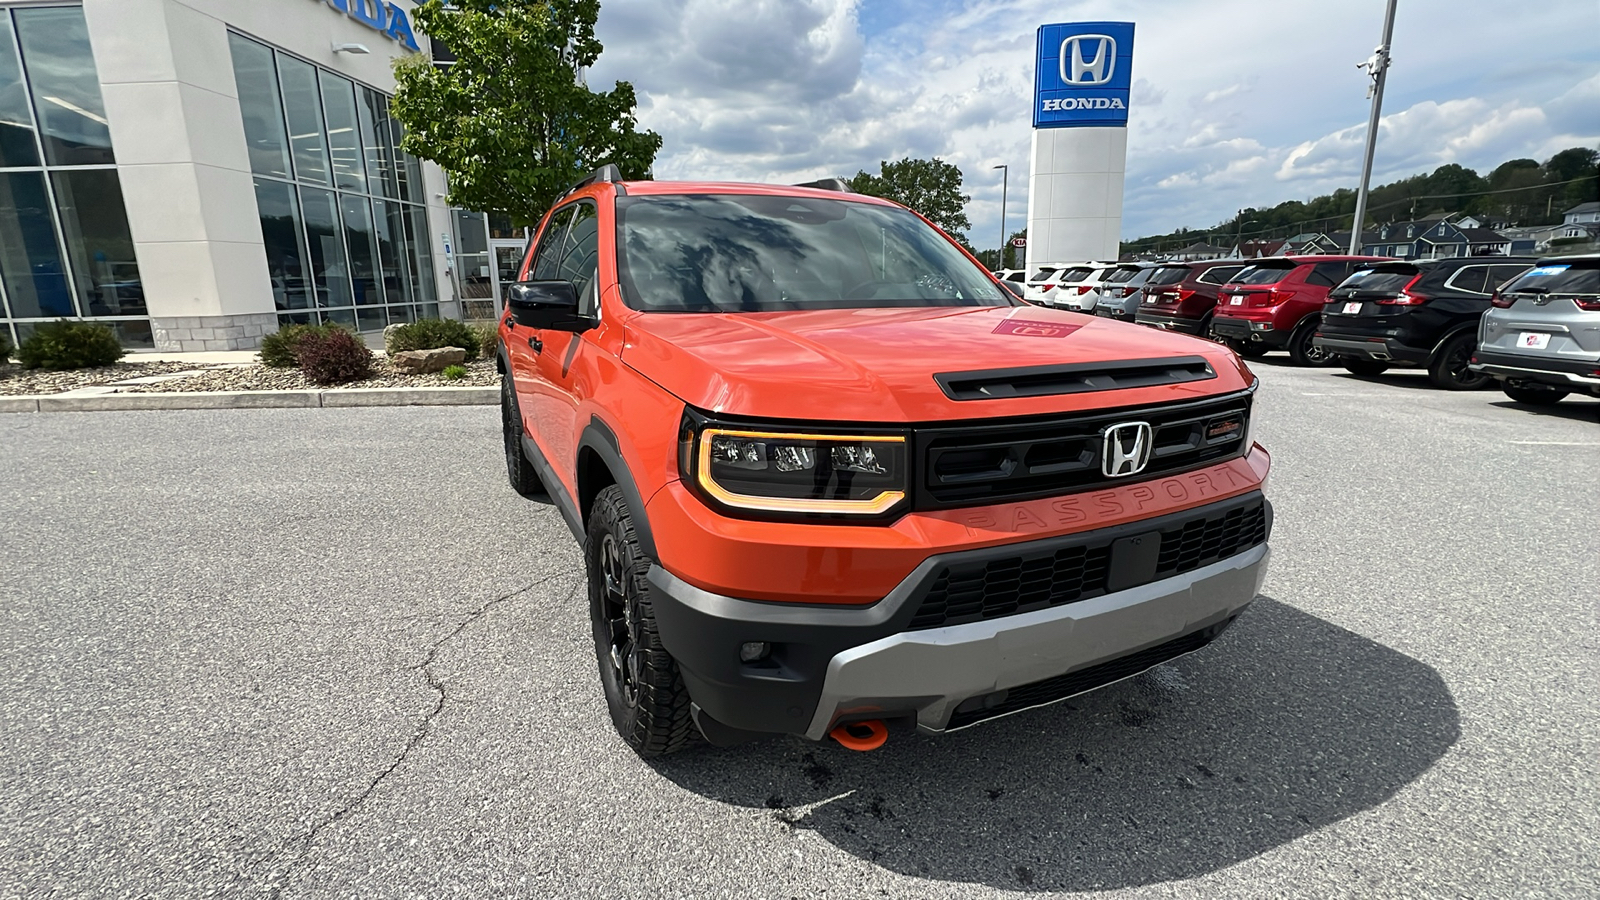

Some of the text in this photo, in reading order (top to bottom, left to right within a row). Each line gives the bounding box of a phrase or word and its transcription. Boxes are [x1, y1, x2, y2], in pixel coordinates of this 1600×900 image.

[324, 0, 420, 52] DA
[1042, 98, 1126, 111] HONDA
[962, 464, 1241, 537] PASSPORT
